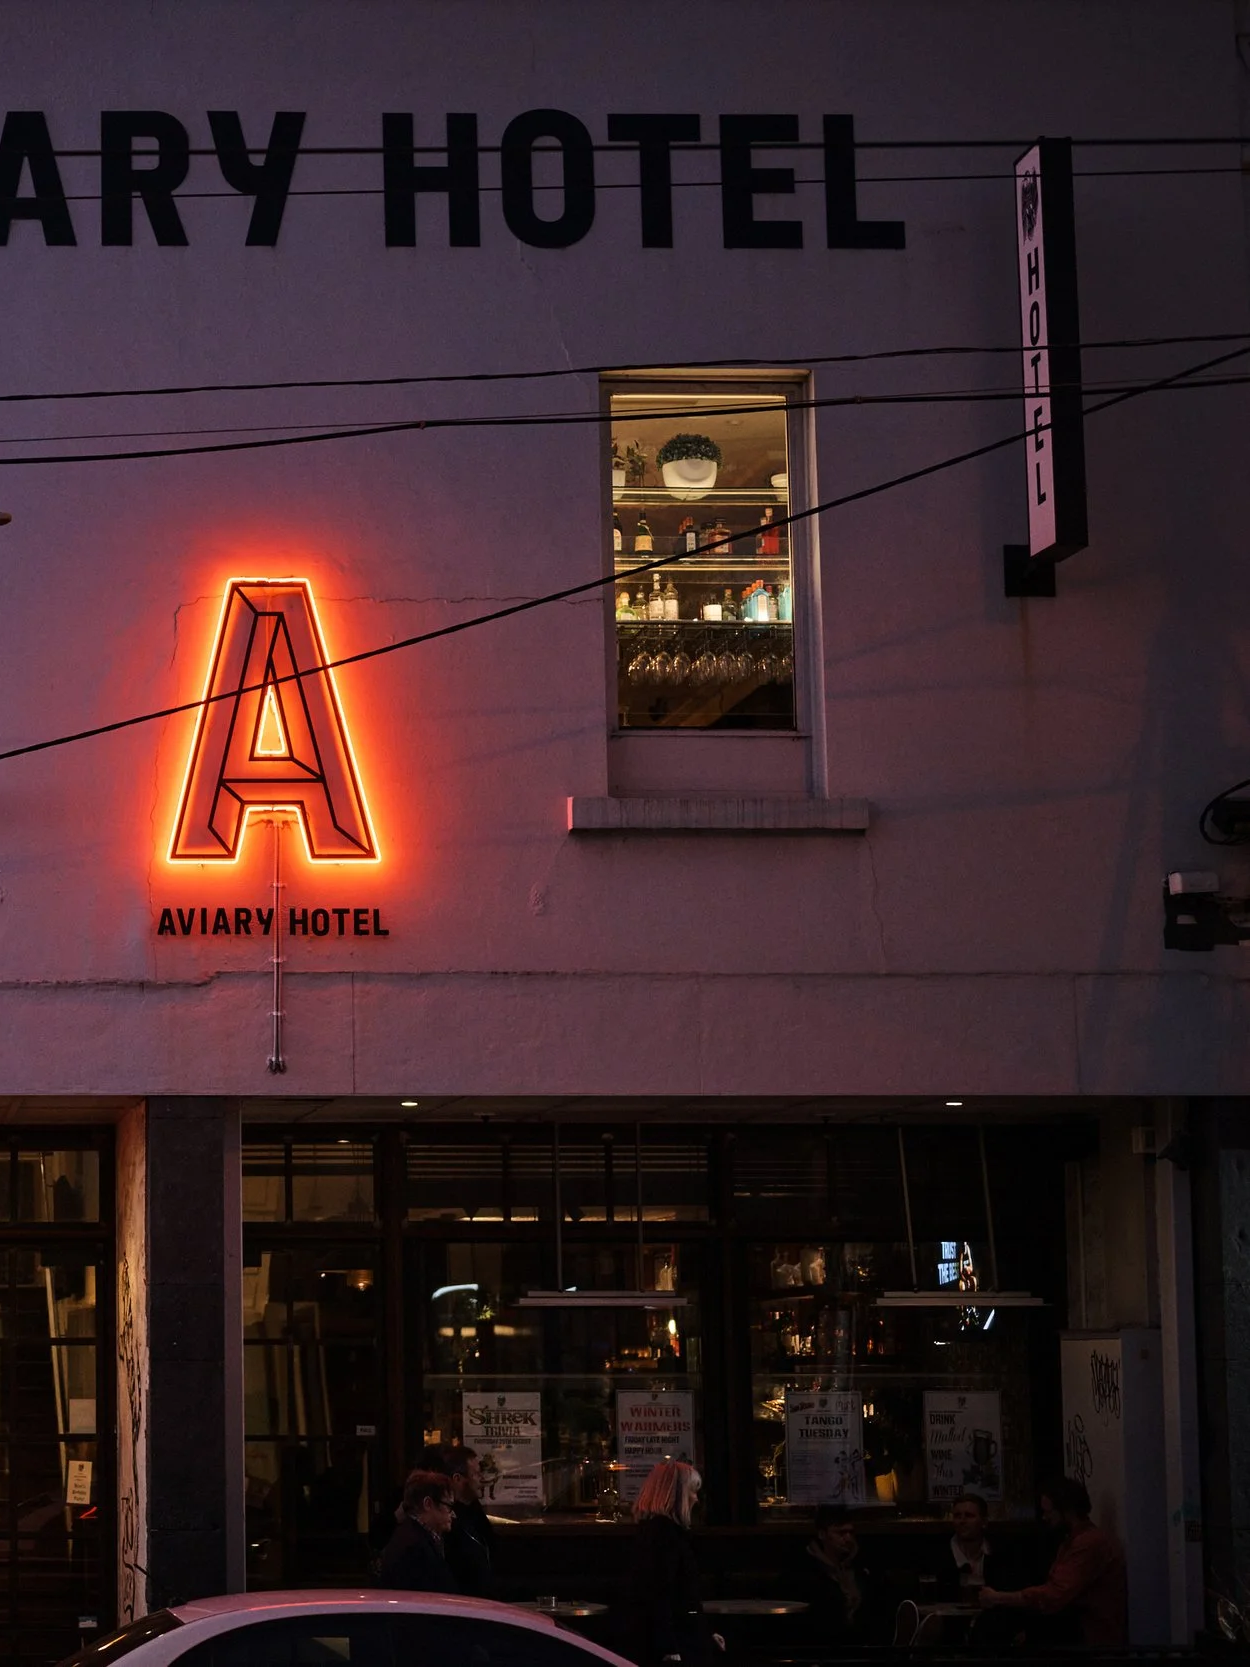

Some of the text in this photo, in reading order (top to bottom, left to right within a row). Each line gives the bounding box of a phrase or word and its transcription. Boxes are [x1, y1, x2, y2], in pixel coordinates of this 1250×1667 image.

[382, 108, 906, 251] HOTEL
[1026, 247, 1047, 506] HOTEL
[166, 577, 382, 864] A
[157, 907, 390, 937] AVIARY HOTEL
[630, 1407, 681, 1418] WINTER
[805, 1416, 843, 1425] TANGO
[929, 1414, 955, 1425] DRINK
[621, 1421, 691, 1432] WARMERS
[799, 1429, 849, 1438] TUESDAY
